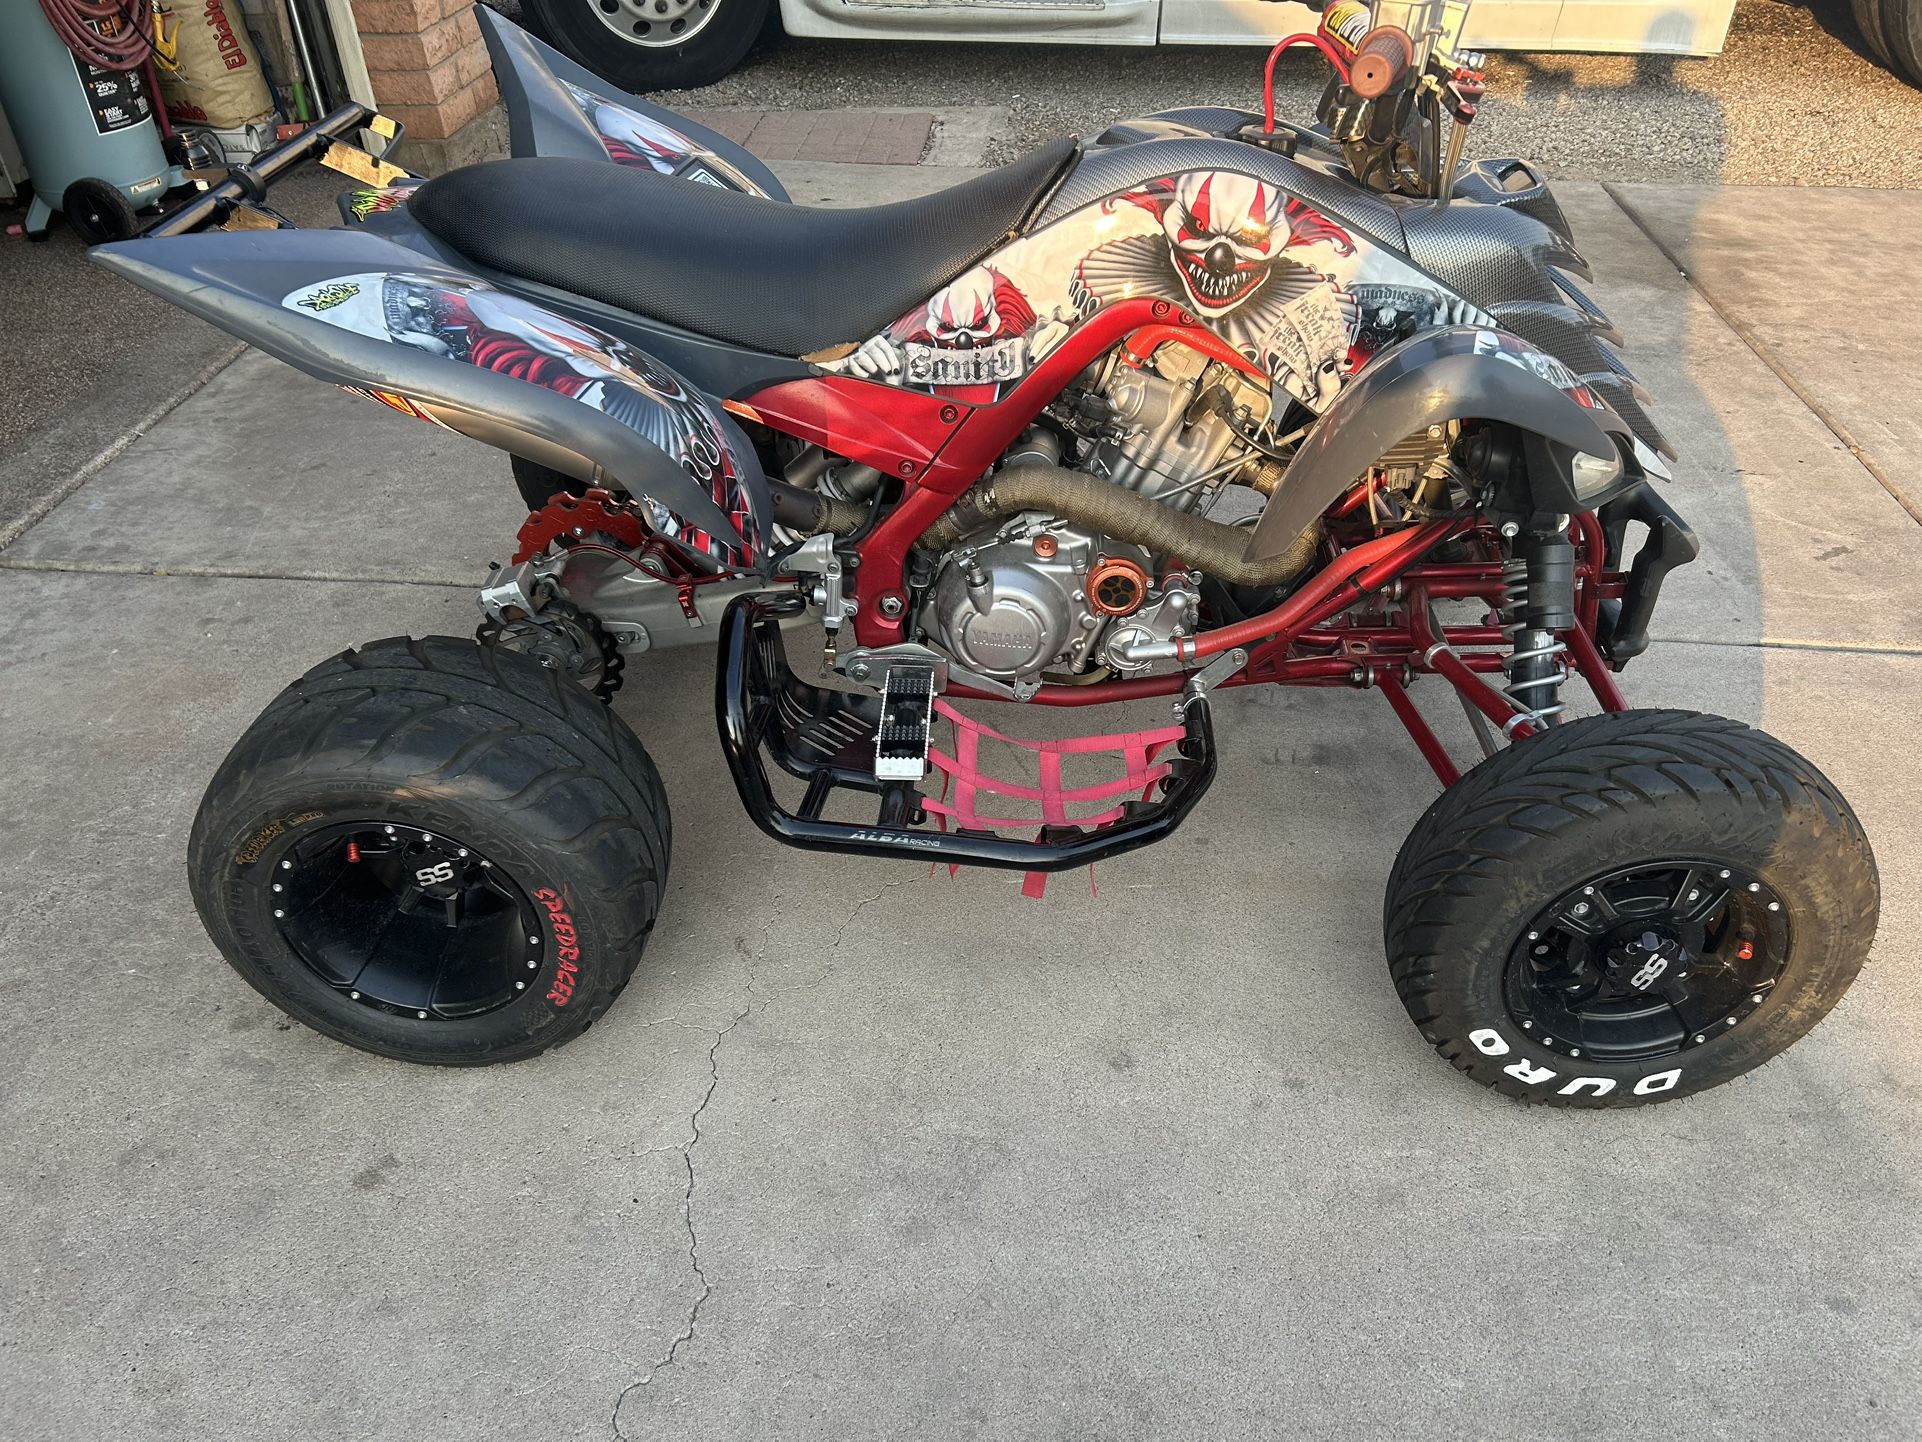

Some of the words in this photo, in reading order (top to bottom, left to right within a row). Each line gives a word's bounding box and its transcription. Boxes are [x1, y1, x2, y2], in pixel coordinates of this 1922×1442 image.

[222, 48, 247, 70] El
[95, 81, 118, 93] 25%
[1360, 286, 1427, 303] madness
[973, 629, 1033, 649] YAMAHA
[849, 830, 909, 844] ALBA
[909, 838, 941, 847] RACING
[416, 862, 454, 887] SS
[532, 886, 580, 1007] SPEEDRACER
[1630, 952, 1668, 991] SS
[1468, 1028, 1683, 1097] DURO
